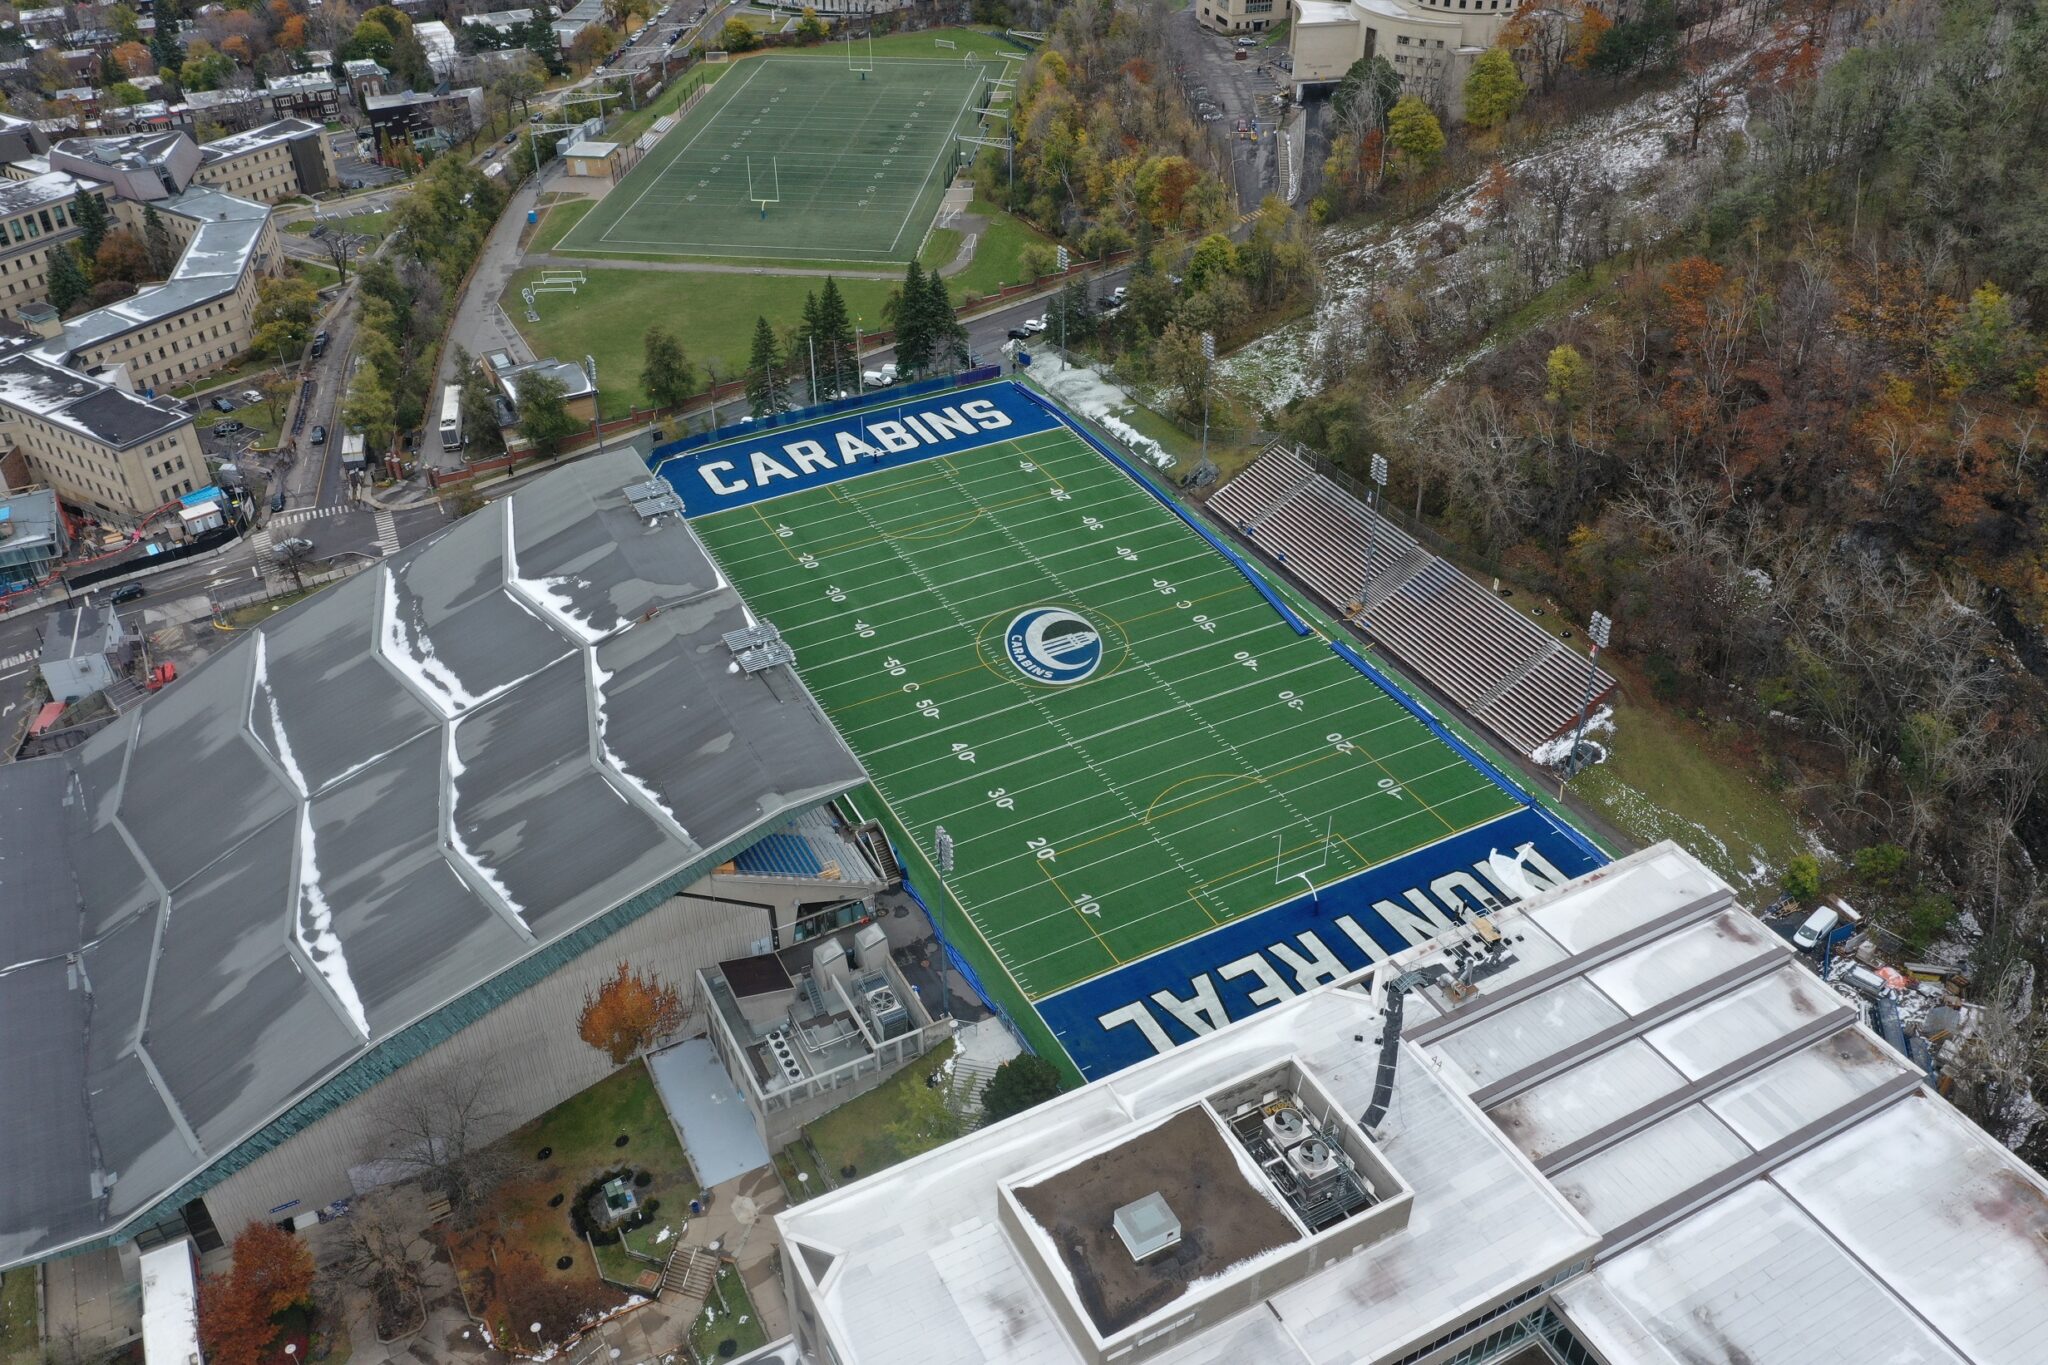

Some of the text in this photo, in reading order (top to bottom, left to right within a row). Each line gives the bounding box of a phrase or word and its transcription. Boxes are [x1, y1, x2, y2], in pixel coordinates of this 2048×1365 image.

[698, 399, 1013, 495] CARABINS
[1050, 489, 1071, 501] 20
[776, 526, 793, 537] 10
[1083, 518, 1103, 530] 30
[799, 555, 819, 568] 20
[1117, 548, 1138, 561] 40
[826, 587, 846, 602] 30
[1154, 580, 1176, 595] 50
[855, 622, 875, 638] 40
[1193, 615, 1216, 631] 50
[1011, 634, 1054, 678] CARABINS
[1234, 651, 1258, 668] 40
[884, 658, 906, 676] 50
[903, 683, 919, 693] C
[916, 699, 939, 716] 50
[1278, 691, 1304, 708] 30
[1326, 733, 1355, 752] 20
[952, 743, 975, 760] 40
[1377, 779, 1402, 796] 10
[988, 788, 1013, 808] 30
[1027, 837, 1055, 859] 20
[1074, 894, 1100, 914] 10
